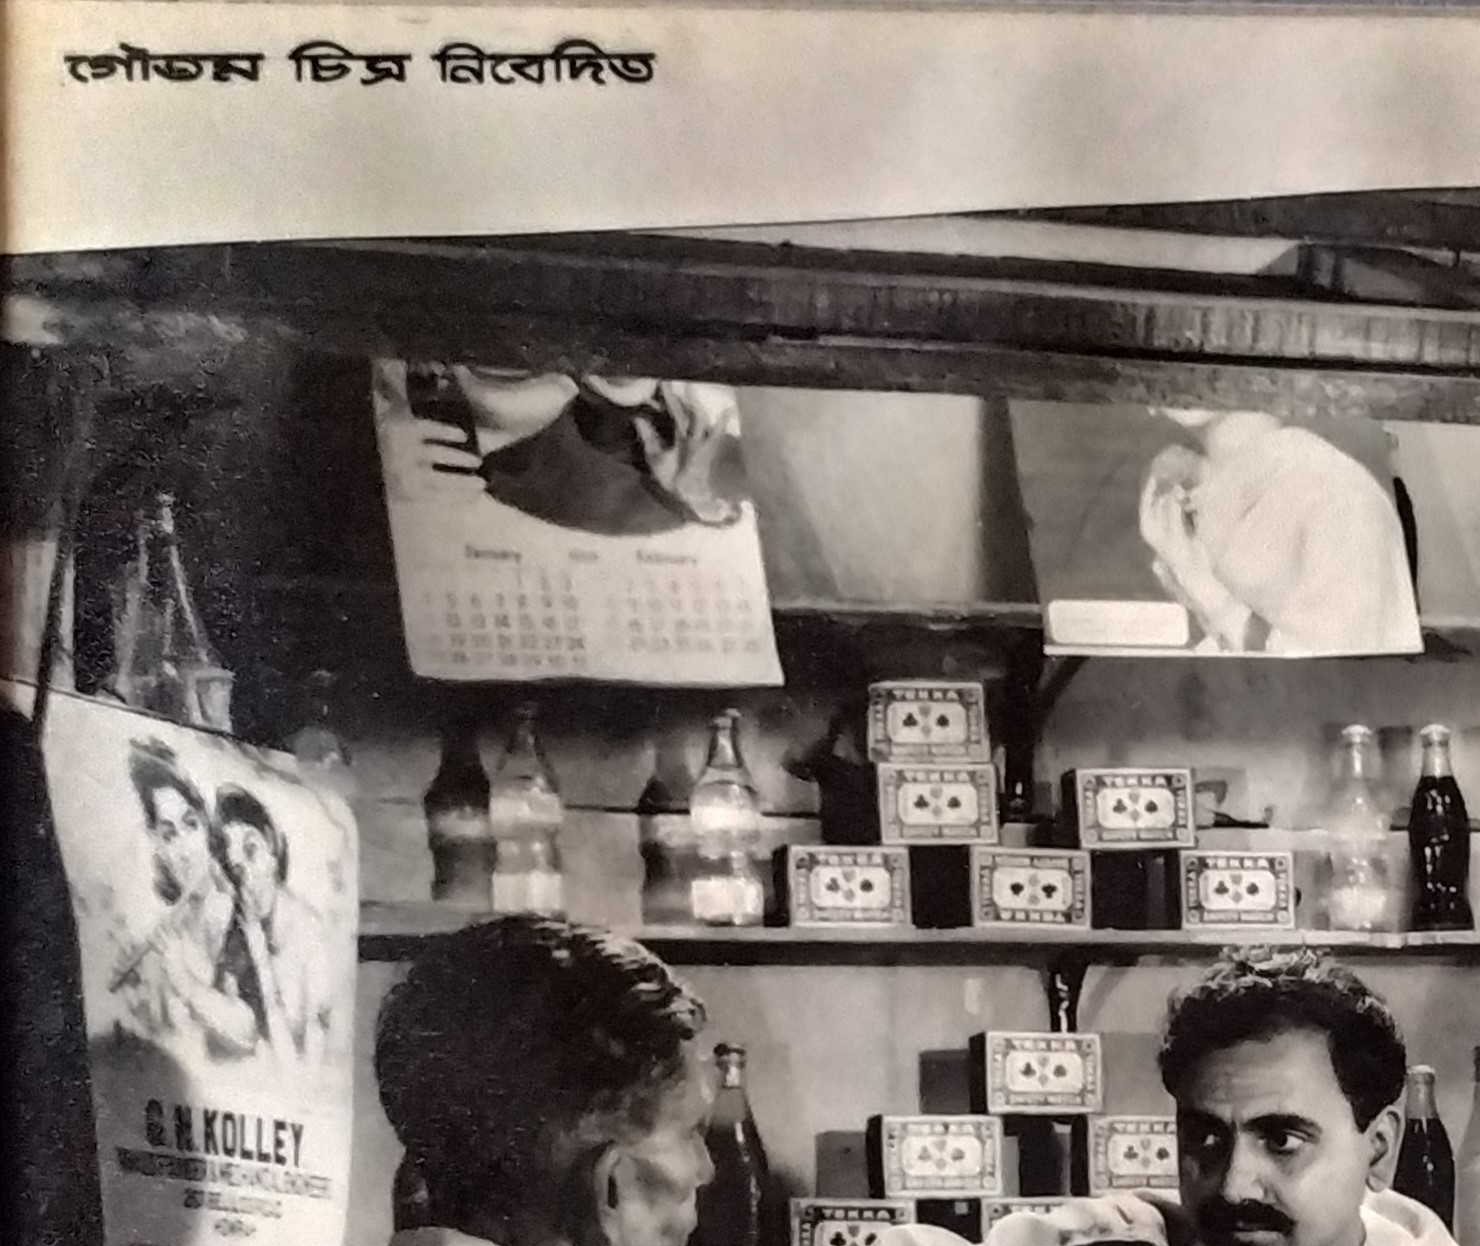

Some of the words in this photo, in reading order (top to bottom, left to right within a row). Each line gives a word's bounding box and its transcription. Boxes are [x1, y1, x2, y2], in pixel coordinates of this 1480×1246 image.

[65, 42, 265, 83] গৌতম
[288, 41, 411, 85] চিত্র
[431, 39, 656, 85] নিবেদিত
[203, 1108, 304, 1168] KOLLEY
